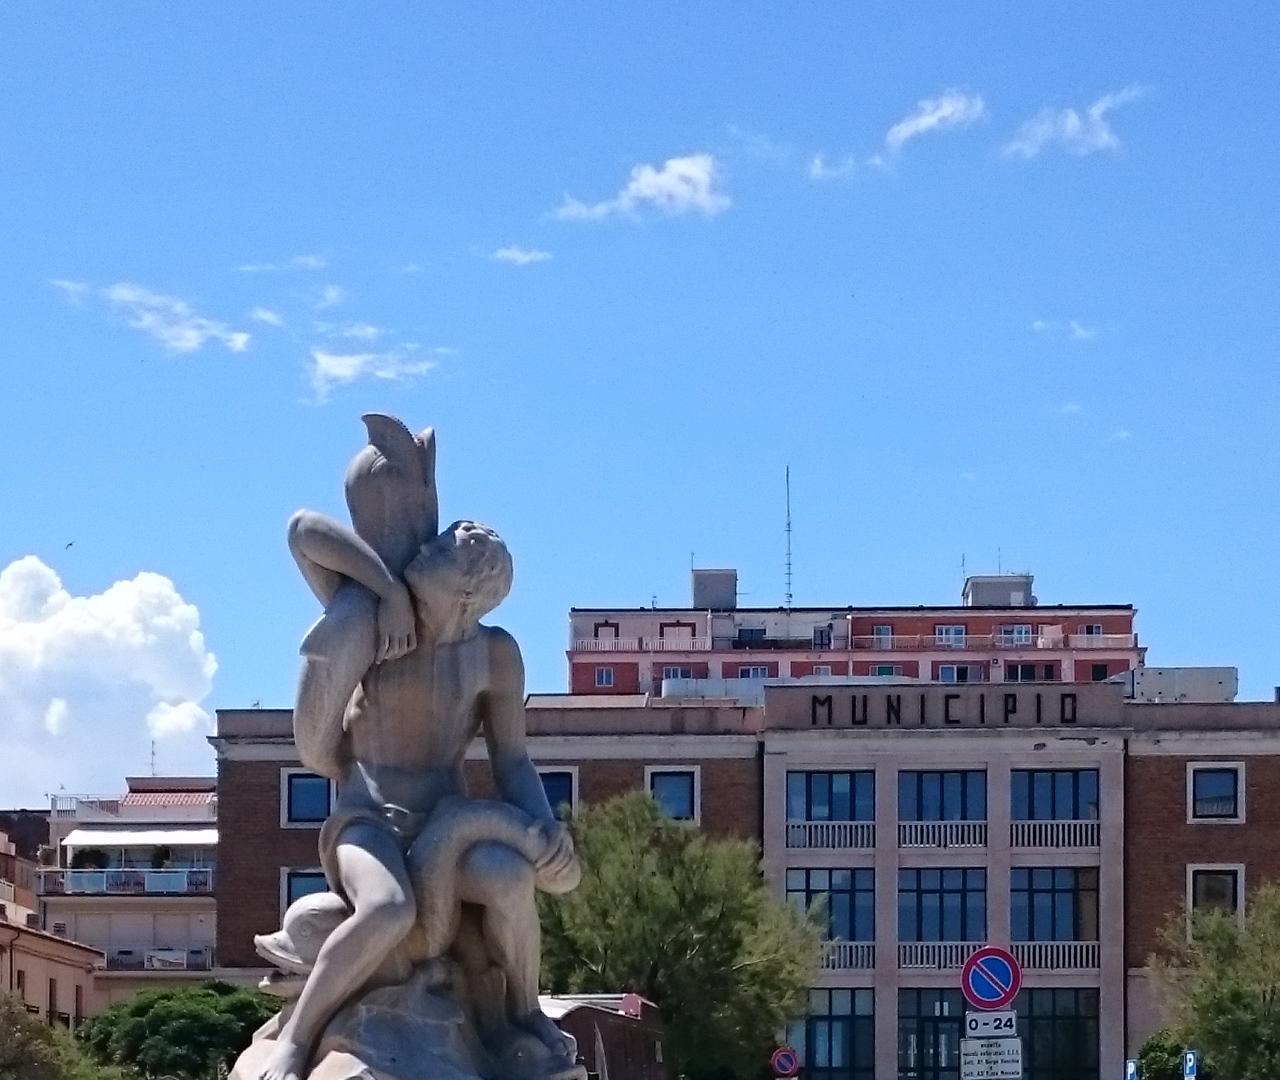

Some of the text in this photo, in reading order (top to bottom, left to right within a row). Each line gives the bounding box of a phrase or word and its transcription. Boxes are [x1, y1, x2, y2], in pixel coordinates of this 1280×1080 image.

[811, 693, 1077, 726] MUNICIPIO
[993, 1017, 1014, 1030] 24
[1127, 1062, 1135, 1080] P
[1186, 1053, 1194, 1074] P
